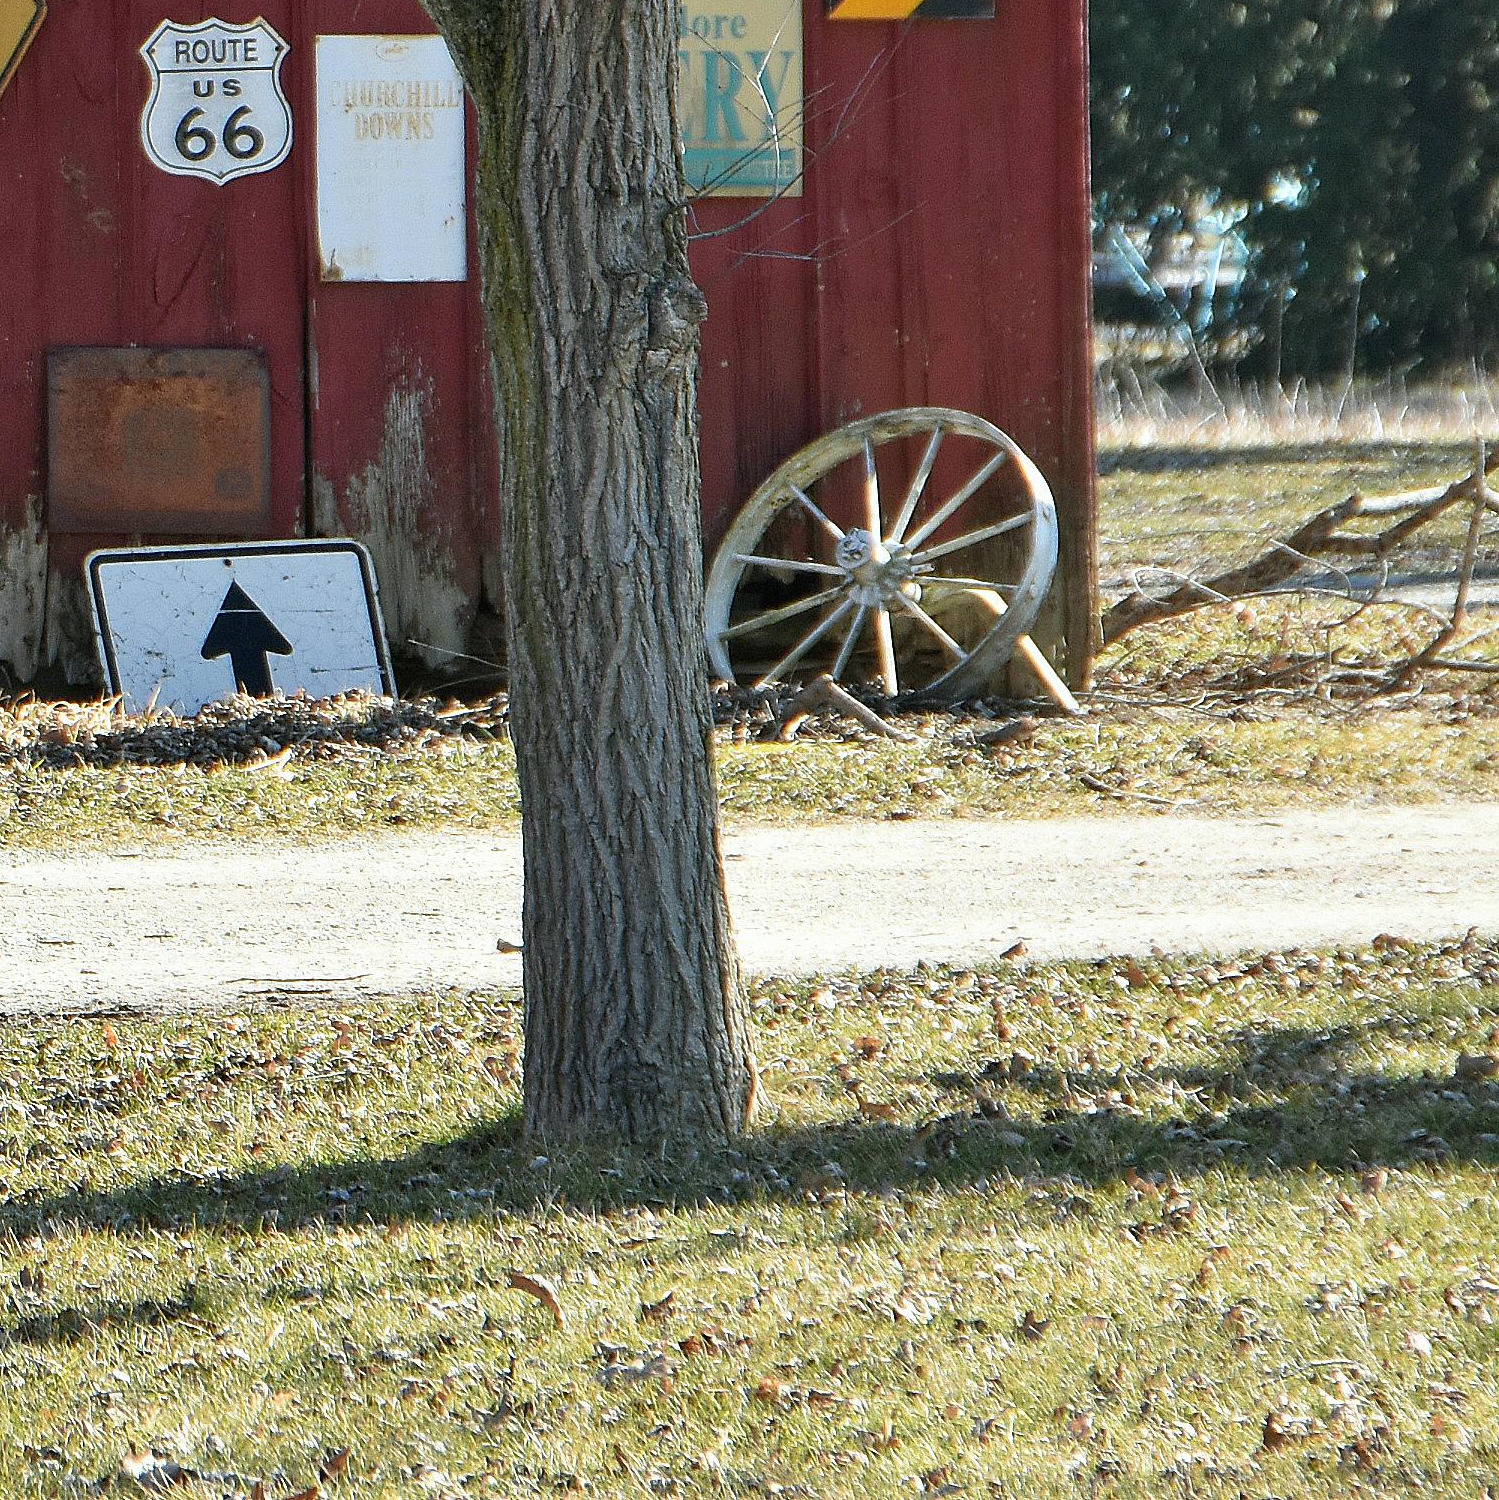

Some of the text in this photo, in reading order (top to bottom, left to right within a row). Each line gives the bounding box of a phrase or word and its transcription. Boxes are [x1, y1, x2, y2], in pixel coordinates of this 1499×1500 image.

[175, 39, 259, 64] ROUTE
[193, 79, 242, 97] US
[175, 105, 264, 162] 66
[356, 113, 435, 140] DOWNS
